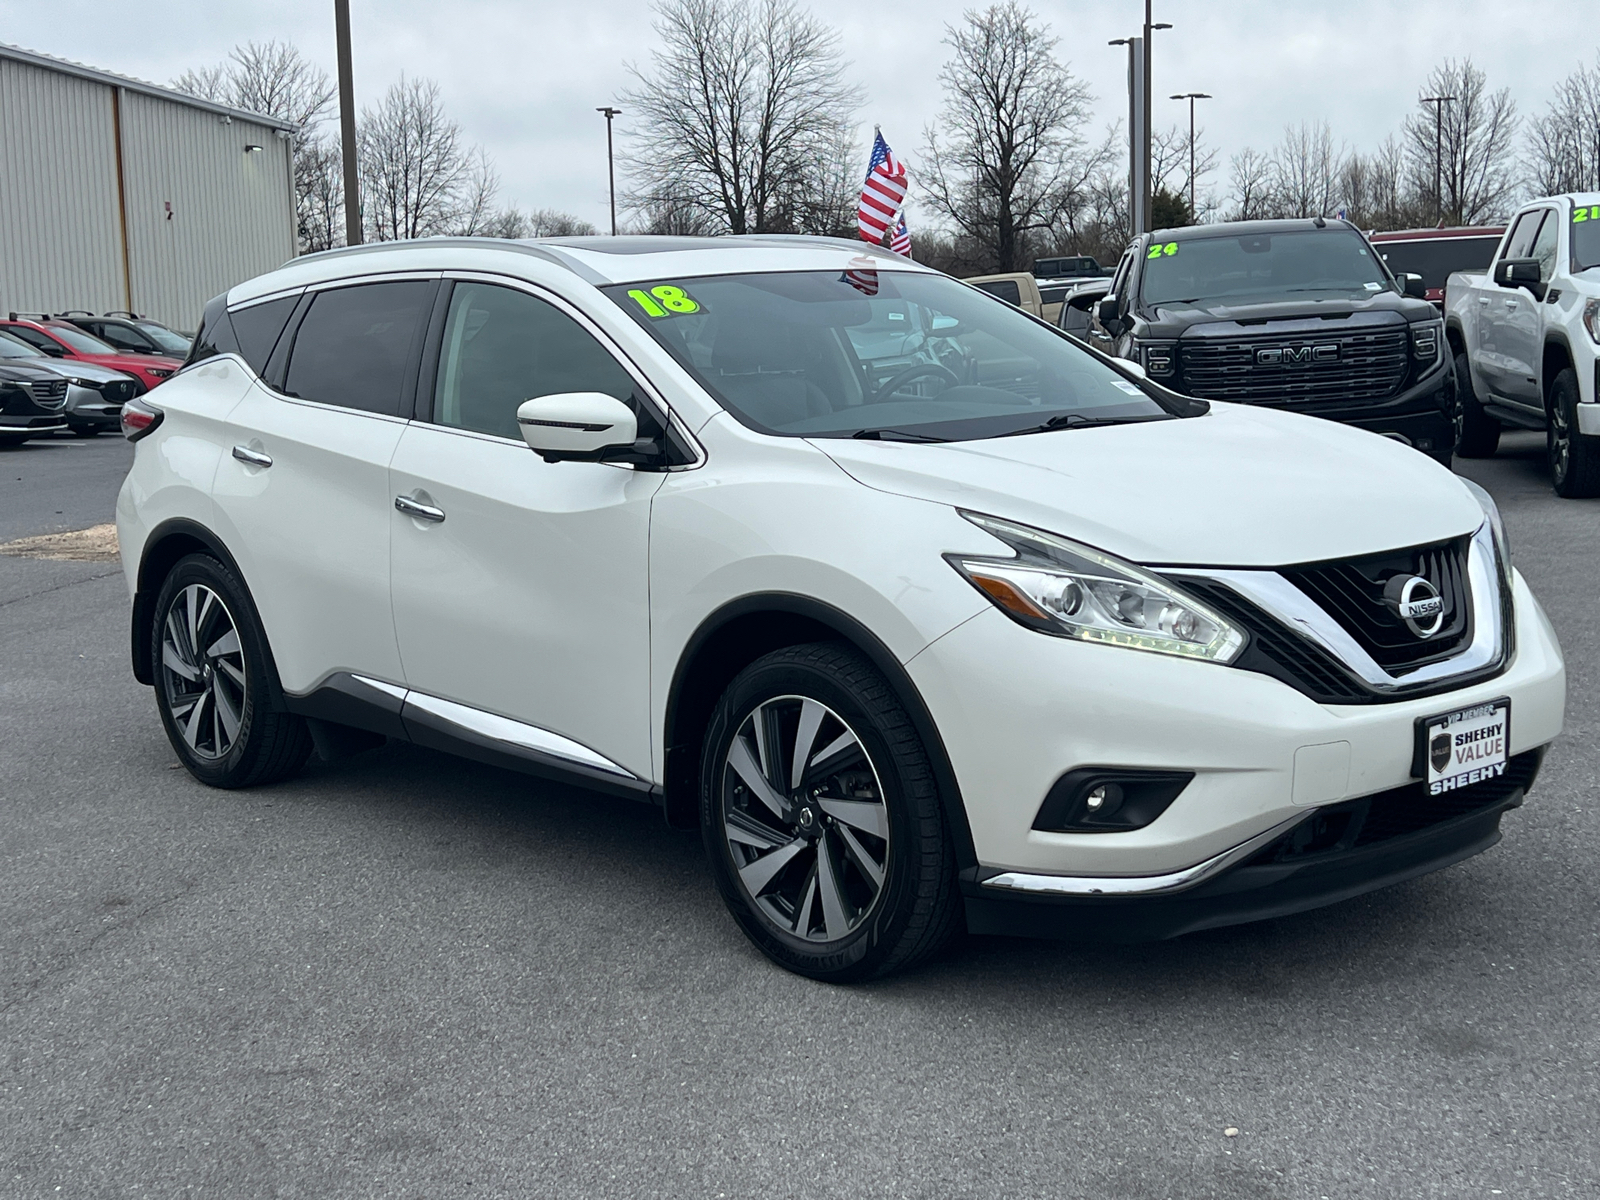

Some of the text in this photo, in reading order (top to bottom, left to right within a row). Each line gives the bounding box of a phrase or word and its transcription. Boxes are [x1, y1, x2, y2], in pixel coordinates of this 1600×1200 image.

[1573, 206, 1600, 223] 21
[1147, 242, 1178, 259] 24
[627, 285, 700, 317] 18
[1256, 345, 1338, 365] GMC
[1447, 704, 1494, 725] VIP MEMBER
[1455, 723, 1503, 746] SHEEHY
[1455, 737, 1503, 764] VALUE
[1429, 761, 1507, 796] SHEEHY
